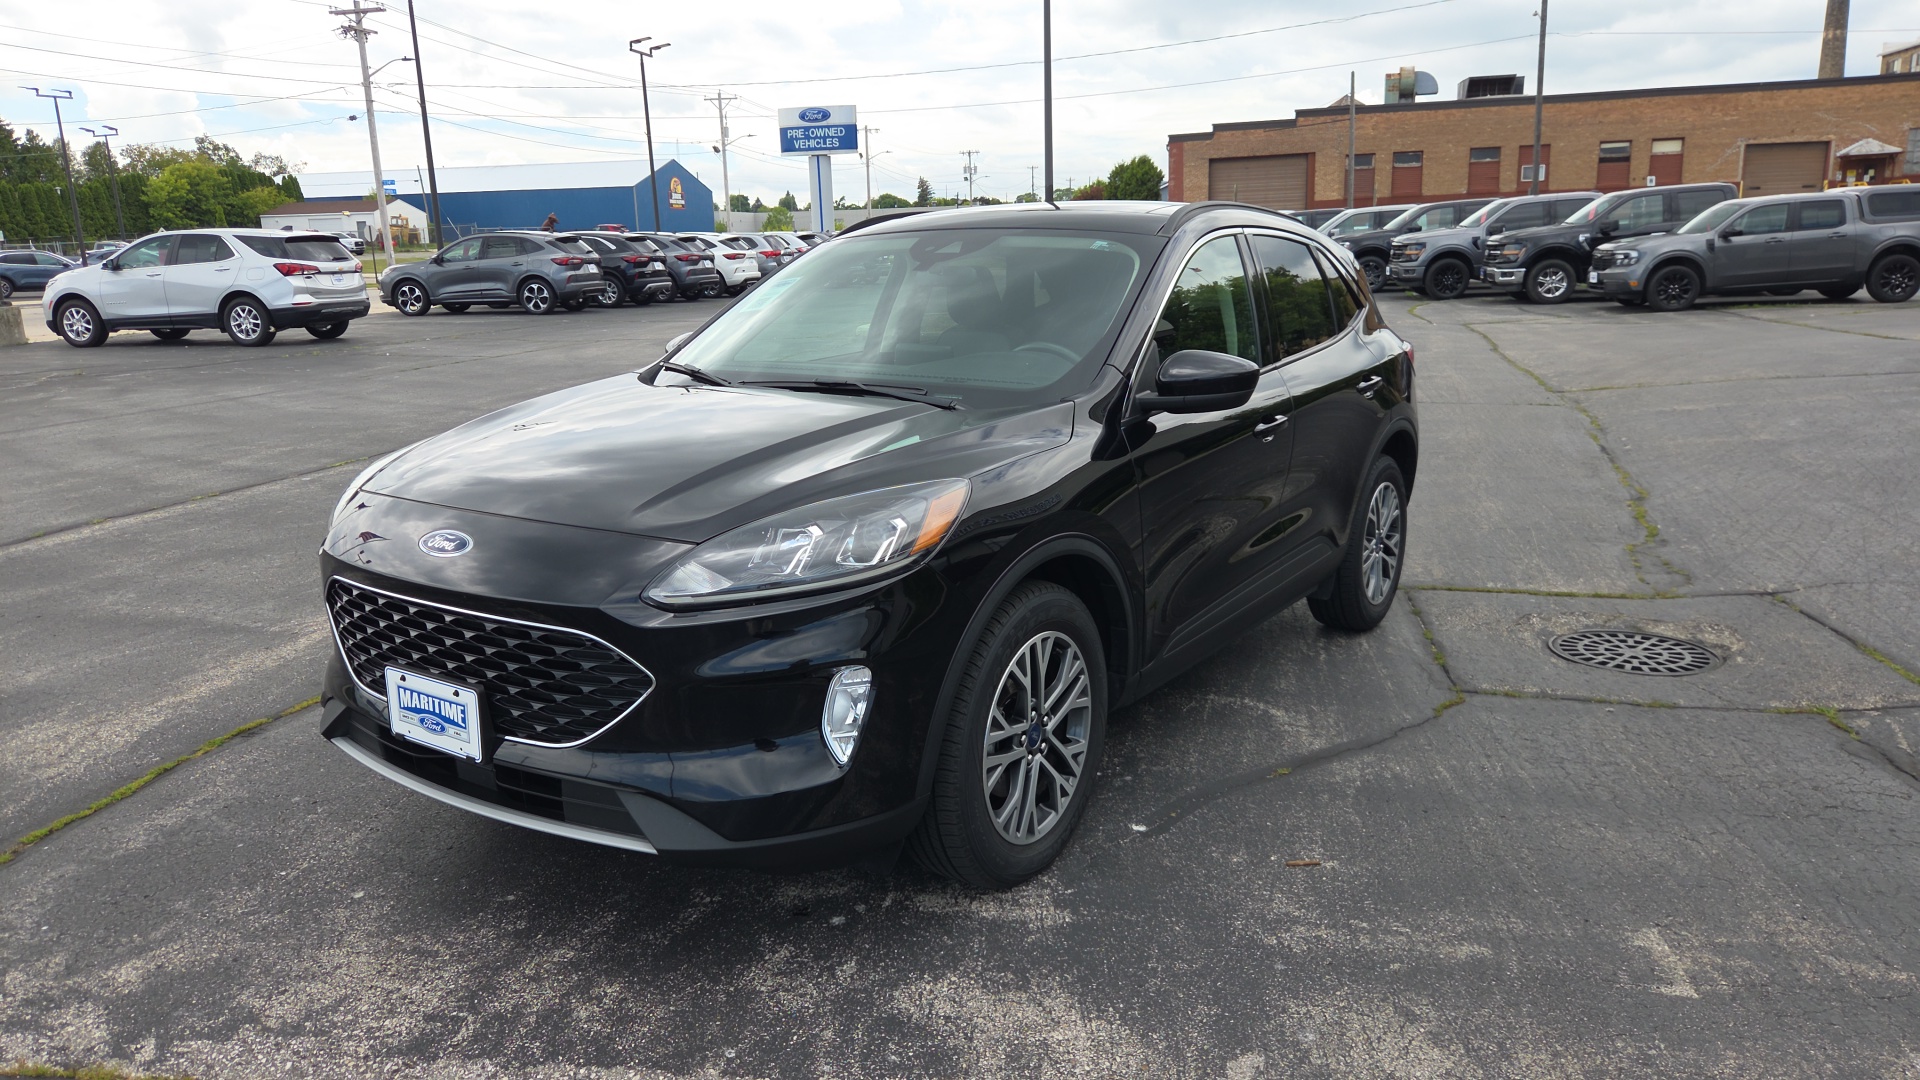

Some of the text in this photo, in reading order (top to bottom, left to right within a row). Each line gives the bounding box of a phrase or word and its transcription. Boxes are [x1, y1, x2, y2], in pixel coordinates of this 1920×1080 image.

[804, 110, 823, 120] Ford
[793, 138, 840, 149] VEHICLES
[427, 533, 460, 551] Ford
[398, 687, 466, 728] MARITIME
[422, 717, 442, 732] Ford
